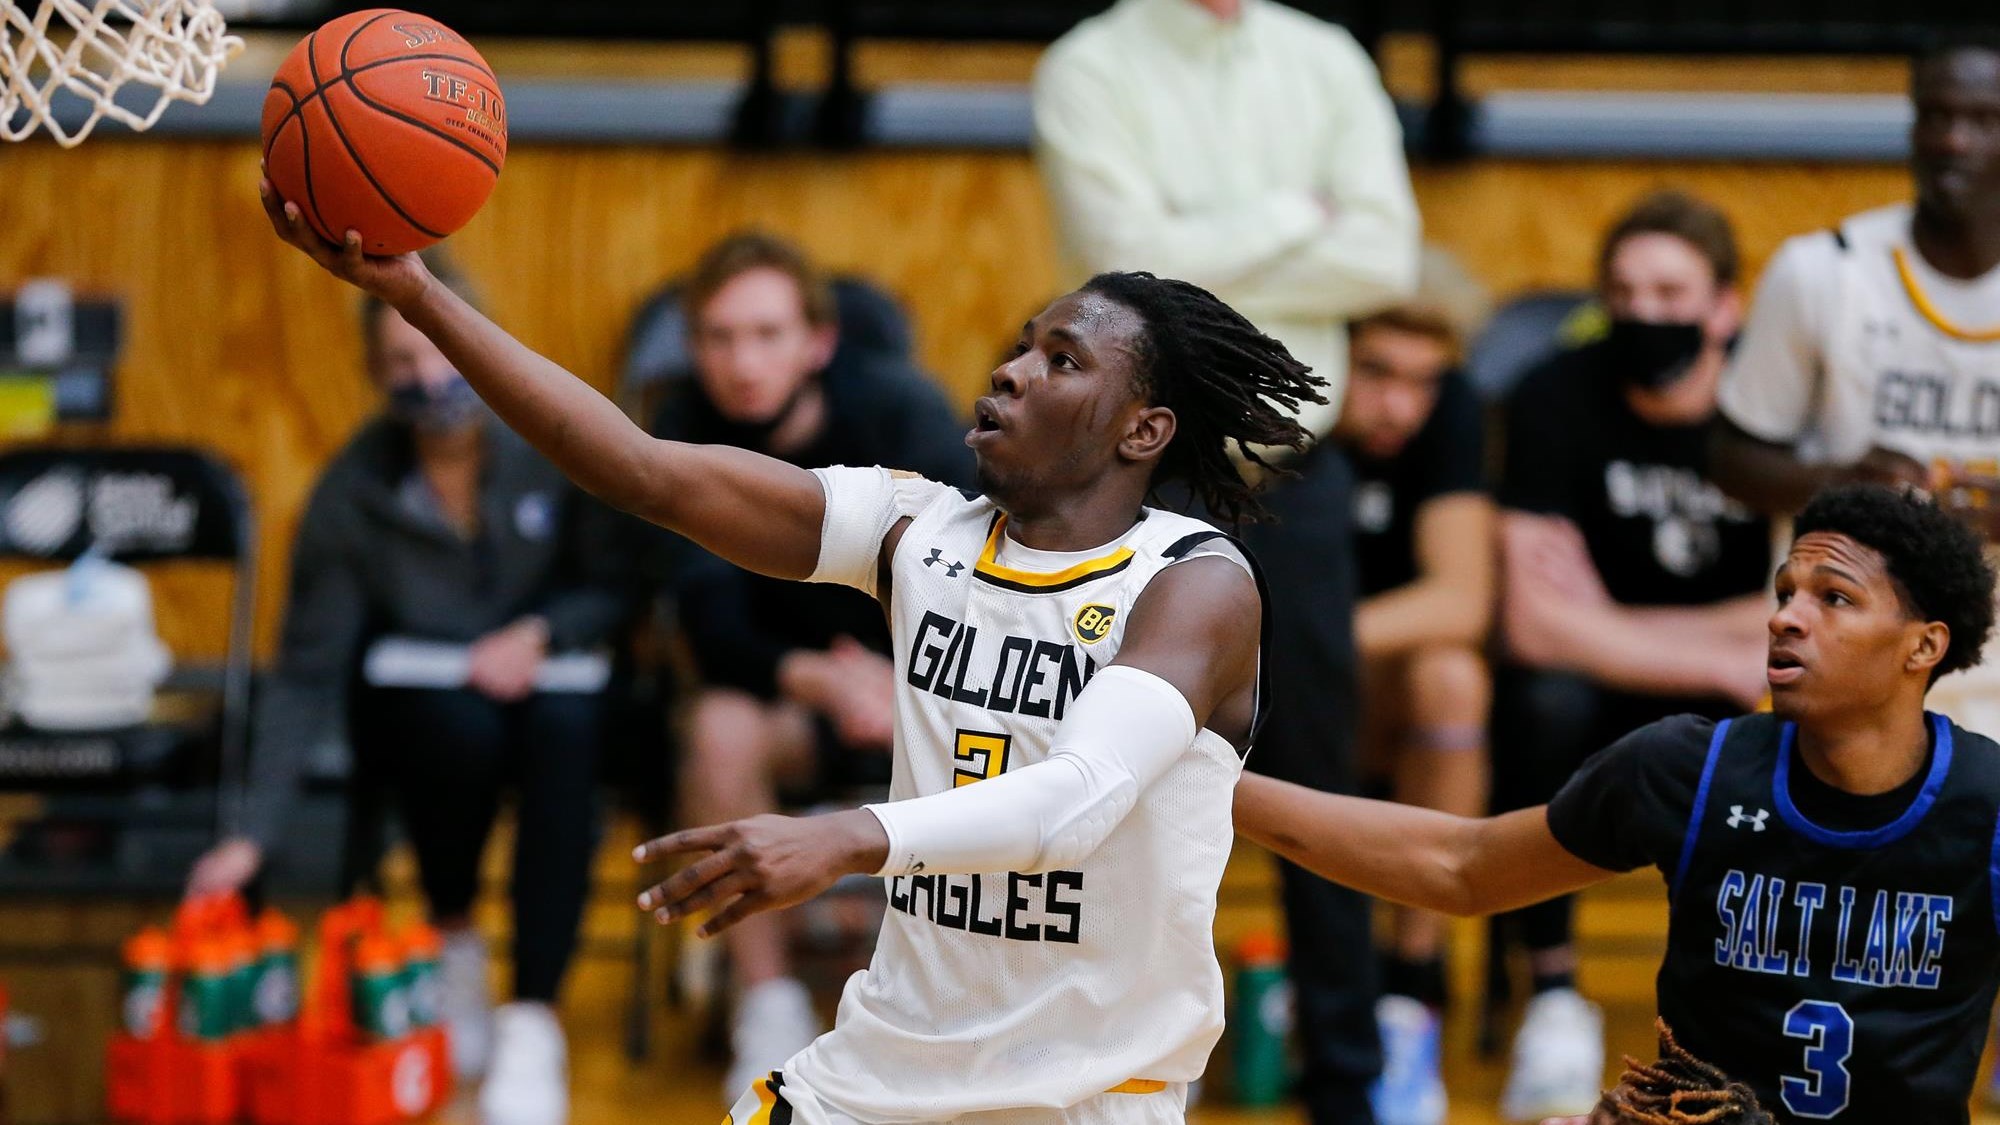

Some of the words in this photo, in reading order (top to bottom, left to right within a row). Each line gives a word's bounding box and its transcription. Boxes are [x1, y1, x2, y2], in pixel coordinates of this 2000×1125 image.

[1078, 607, 1114, 635] BG
[891, 870, 1083, 944] EAGLES
[1715, 869, 1826, 977] SALT
[1832, 886, 1953, 989] LAKE
[1780, 999, 1854, 1119] 3
